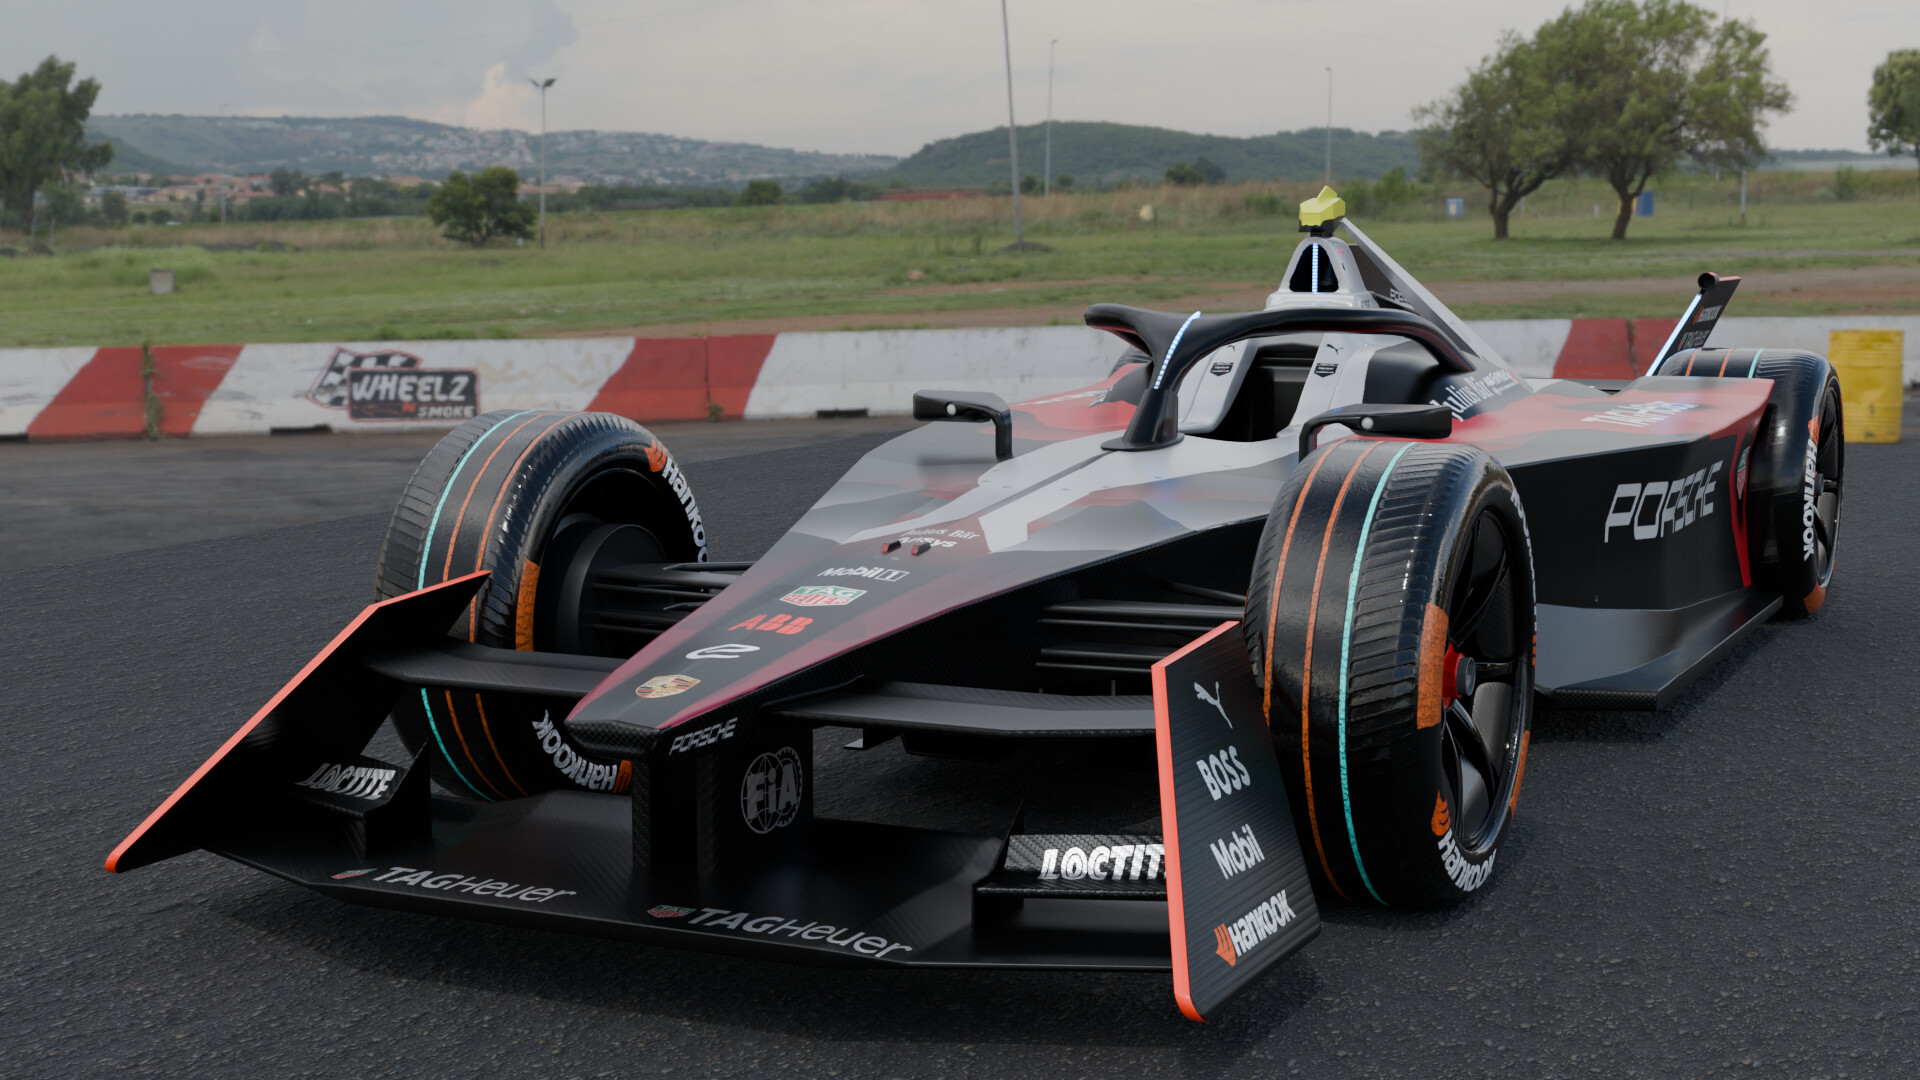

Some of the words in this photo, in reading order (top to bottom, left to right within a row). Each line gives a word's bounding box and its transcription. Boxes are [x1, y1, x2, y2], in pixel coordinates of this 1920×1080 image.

[352, 374, 469, 401] WHEELZ
[417, 406, 474, 418] SMOKE
[662, 455, 709, 563] Hankoo
[1604, 460, 1723, 543] PORSCHE
[783, 594, 852, 606] HEUER
[798, 587, 858, 599] TAG
[728, 614, 813, 635] ABB
[668, 717, 738, 756] PORSCHE
[295, 763, 396, 800] LOCTITE
[1196, 745, 1251, 801] BOSS
[1037, 843, 1167, 880] LOCTIT
[1210, 823, 1265, 880] Mobil
[1227, 889, 1296, 957] Hankook
